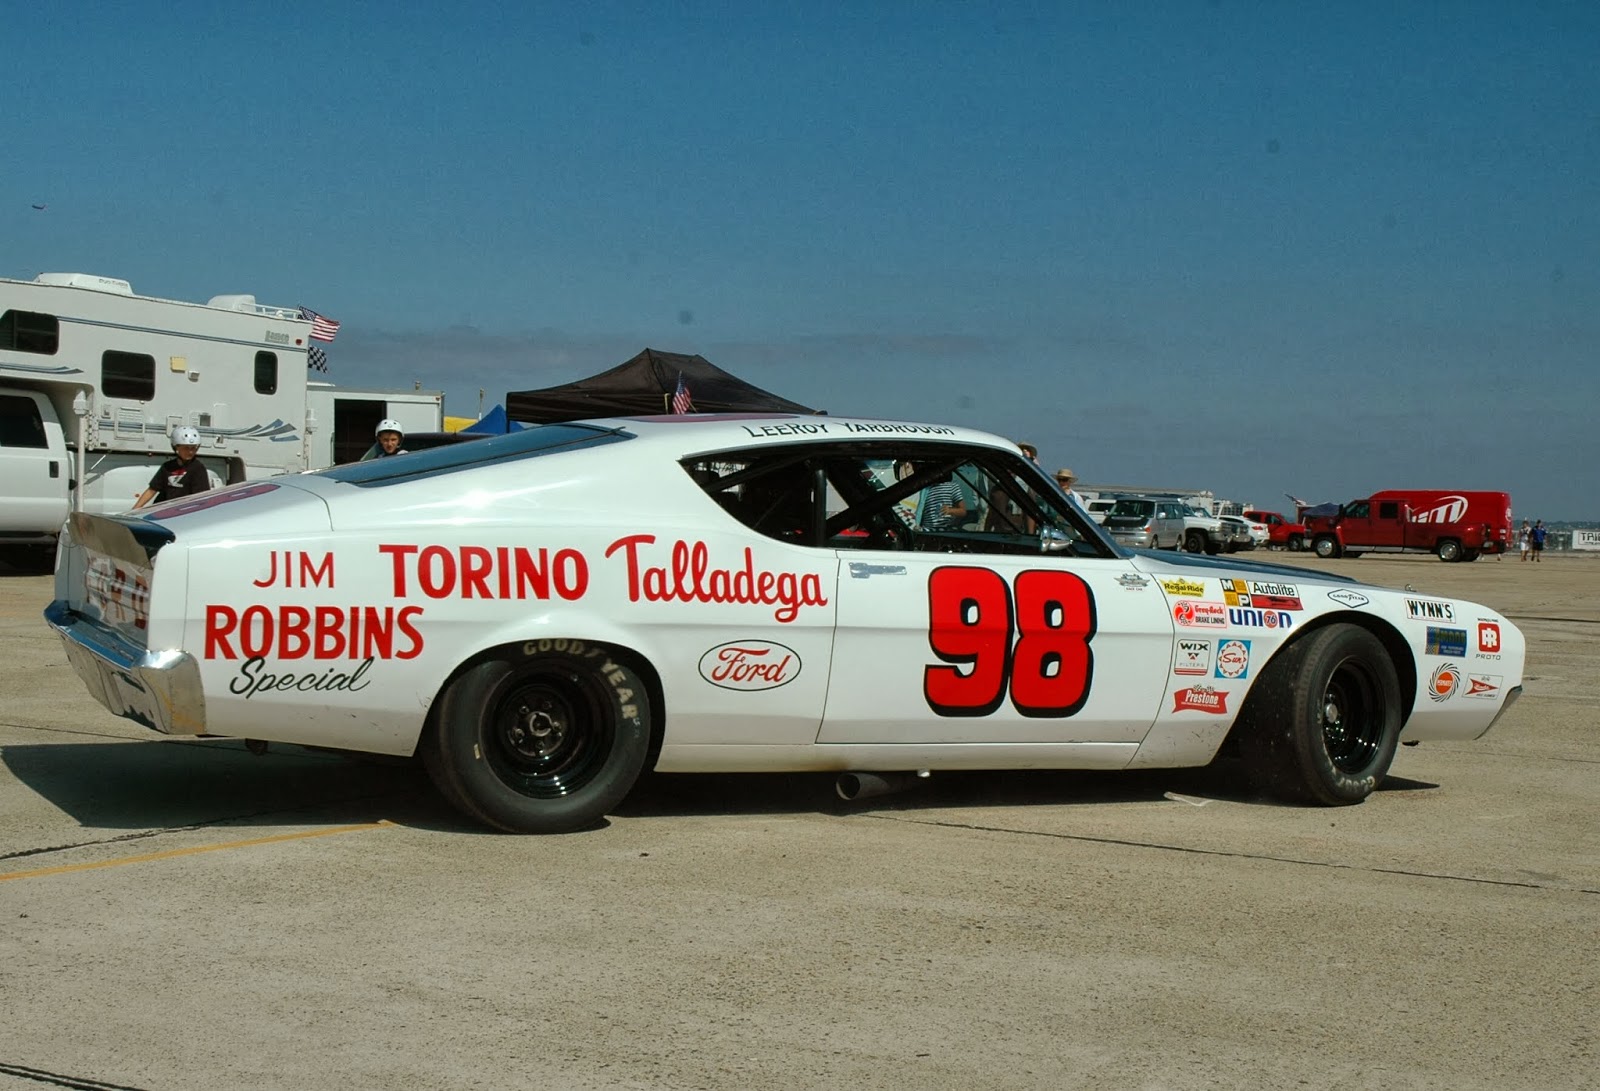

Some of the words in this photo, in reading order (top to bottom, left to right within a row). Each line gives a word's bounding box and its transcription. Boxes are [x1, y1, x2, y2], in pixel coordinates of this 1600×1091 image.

[252, 550, 335, 589] JIM
[378, 543, 590, 601] TORINO
[604, 533, 829, 624] Talladega
[1253, 582, 1295, 597] Autolite
[1406, 600, 1453, 620] WYNN'S
[203, 604, 425, 661] ROBBINS
[922, 565, 1098, 719] 98
[1180, 642, 1209, 651] WIX
[711, 646, 792, 684] Ford
[1222, 652, 1242, 664] Sun
[1475, 653, 1502, 661] PROTO
[229, 655, 376, 700] Special
[1185, 689, 1219, 705] Prestone
